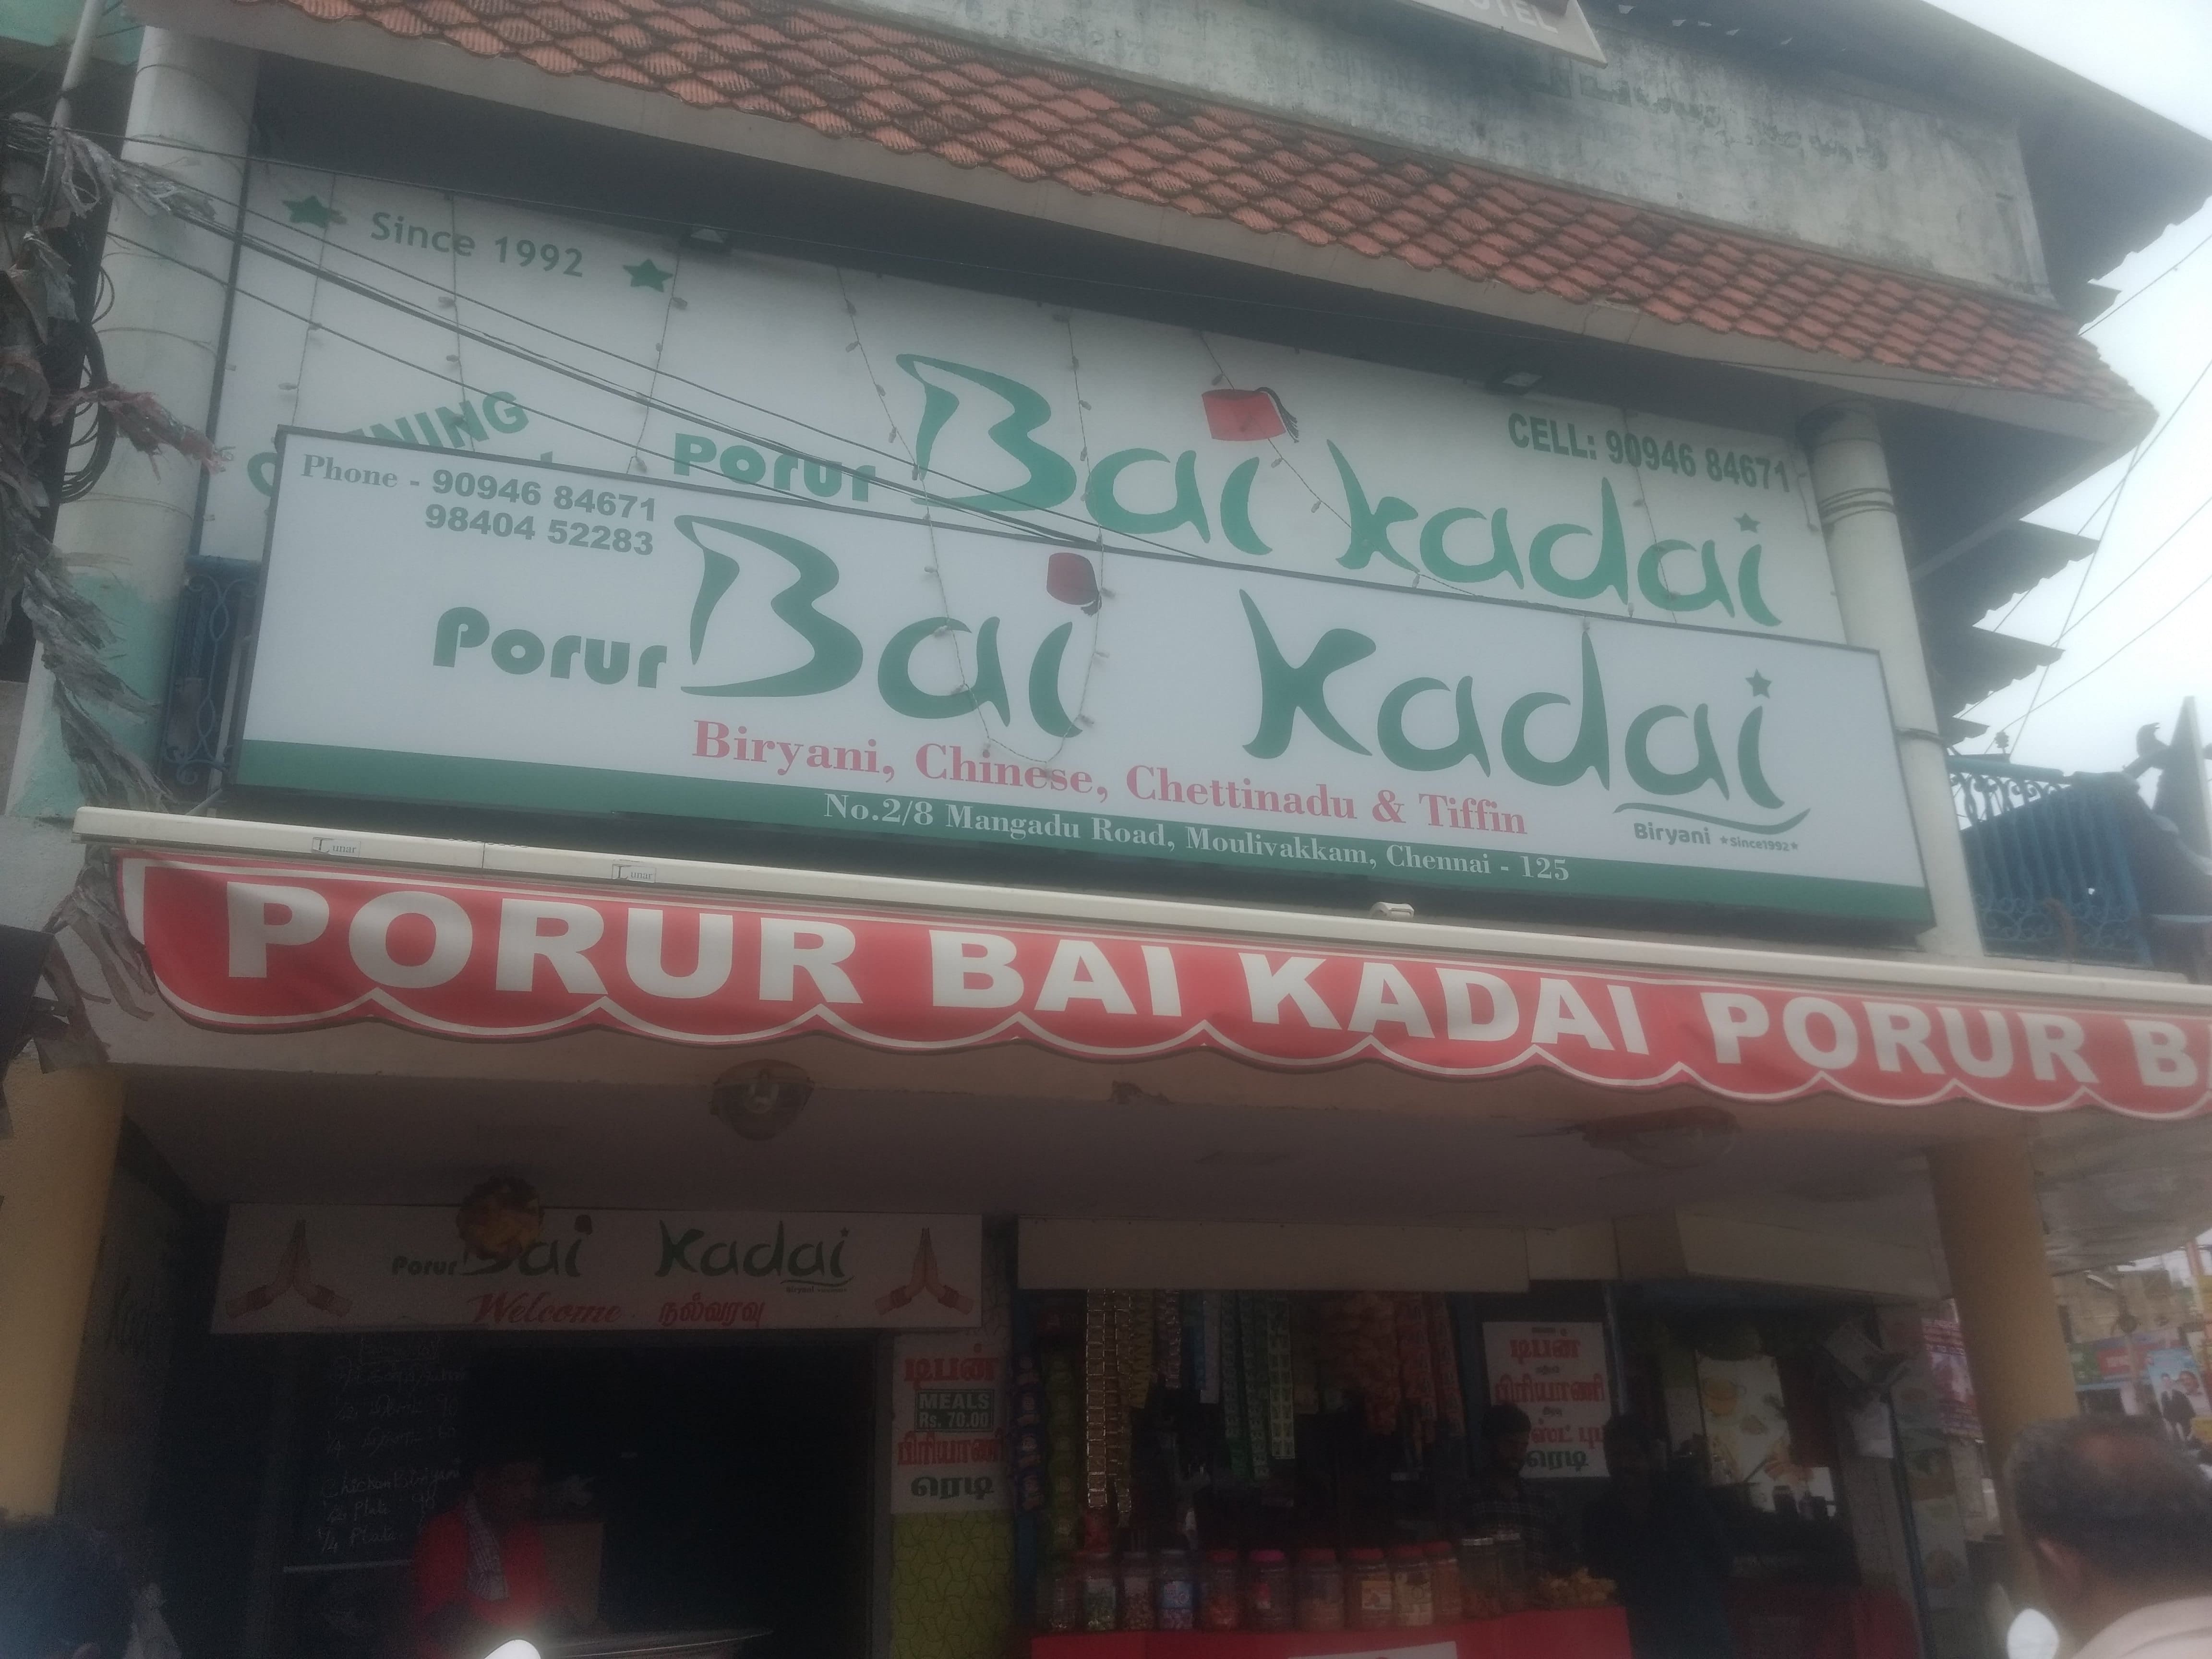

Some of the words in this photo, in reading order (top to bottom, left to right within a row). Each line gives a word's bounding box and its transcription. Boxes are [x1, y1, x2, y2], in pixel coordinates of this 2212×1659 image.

[371, 212, 475, 256] Since
[495, 236, 583, 277] 1992
[301, 453, 398, 489] Phone
[432, 469, 541, 506] 90946
[553, 484, 656, 522] 84671
[895, 353, 1273, 555] Bai
[1508, 413, 1597, 460] CELL:
[1605, 430, 1696, 478] 90946
[1706, 447, 1790, 493] 84671
[425, 503, 535, 541] 98404
[547, 518, 653, 555] 52283
[432, 606, 667, 688] Porur
[674, 515, 1083, 738] Bai
[692, 719, 895, 782] Biryani,
[915, 743, 1108, 803] Chinese,
[1126, 764, 1358, 820] Chettinadu
[1371, 789, 1407, 824] &
[1419, 792, 1528, 835] Tiffin
[823, 792, 934, 827] No.2/8
[945, 803, 1081, 841] Mangadu
[1090, 817, 1175, 853] Road,
[1184, 825, 1377, 869] Moulivakkam,
[1385, 844, 1491, 875] Chennai
[1521, 855, 1570, 881] 125
[1633, 822, 1711, 845] Biryani
[226, 880, 864, 1005] PORUR
[929, 929, 1183, 1018] BAI
[1238, 951, 1650, 1056] KADAI
[1699, 991, 2099, 1084] PORUR
[2123, 1019, 2212, 1090] B
[467, 1290, 622, 1324] Welcome
[919, 1393, 990, 1410] MEALS
[919, 1412, 942, 1428] Rs.
[948, 1412, 989, 1428] 70.00
